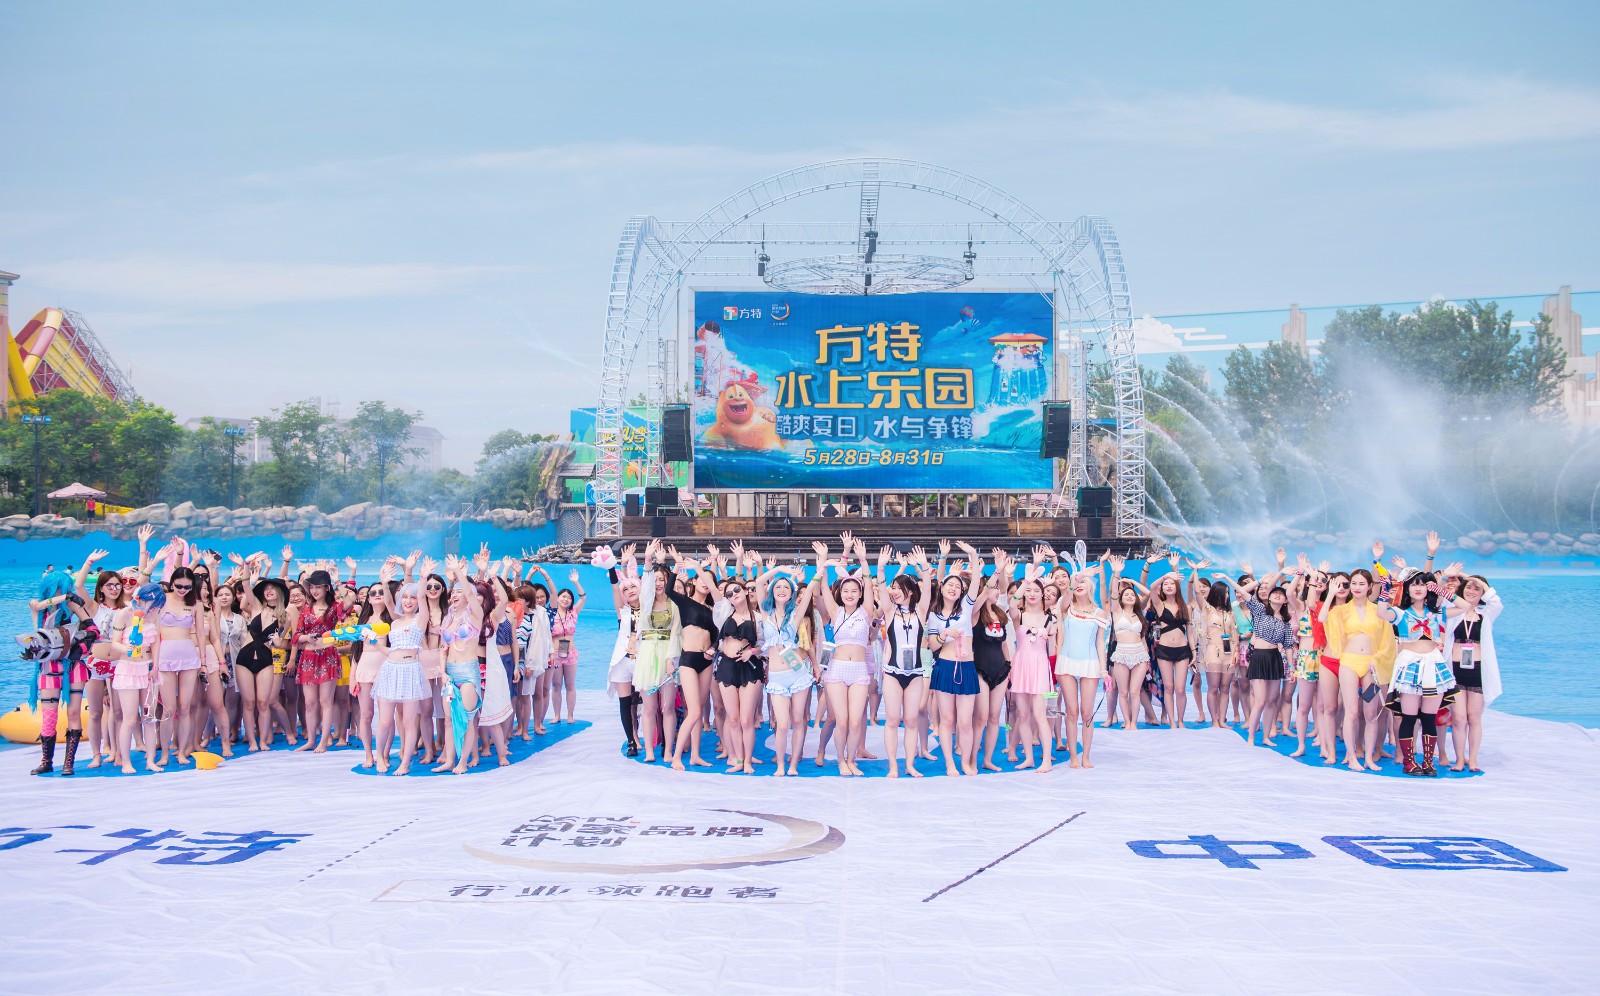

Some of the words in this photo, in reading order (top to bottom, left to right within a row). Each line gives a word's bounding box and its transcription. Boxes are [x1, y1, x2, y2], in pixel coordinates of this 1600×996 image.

[739, 308, 762, 319] 方特
[815, 322, 922, 364] 方特
[774, 367, 975, 409] 水上乐园
[776, 415, 856, 437] 酷爽夏日
[873, 415, 973, 439] 水与争锋
[804, 449, 944, 466] 5月28日-8月31日
[1126, 835, 1568, 872] 中国
[448, 885, 783, 899] 行业领跑者
